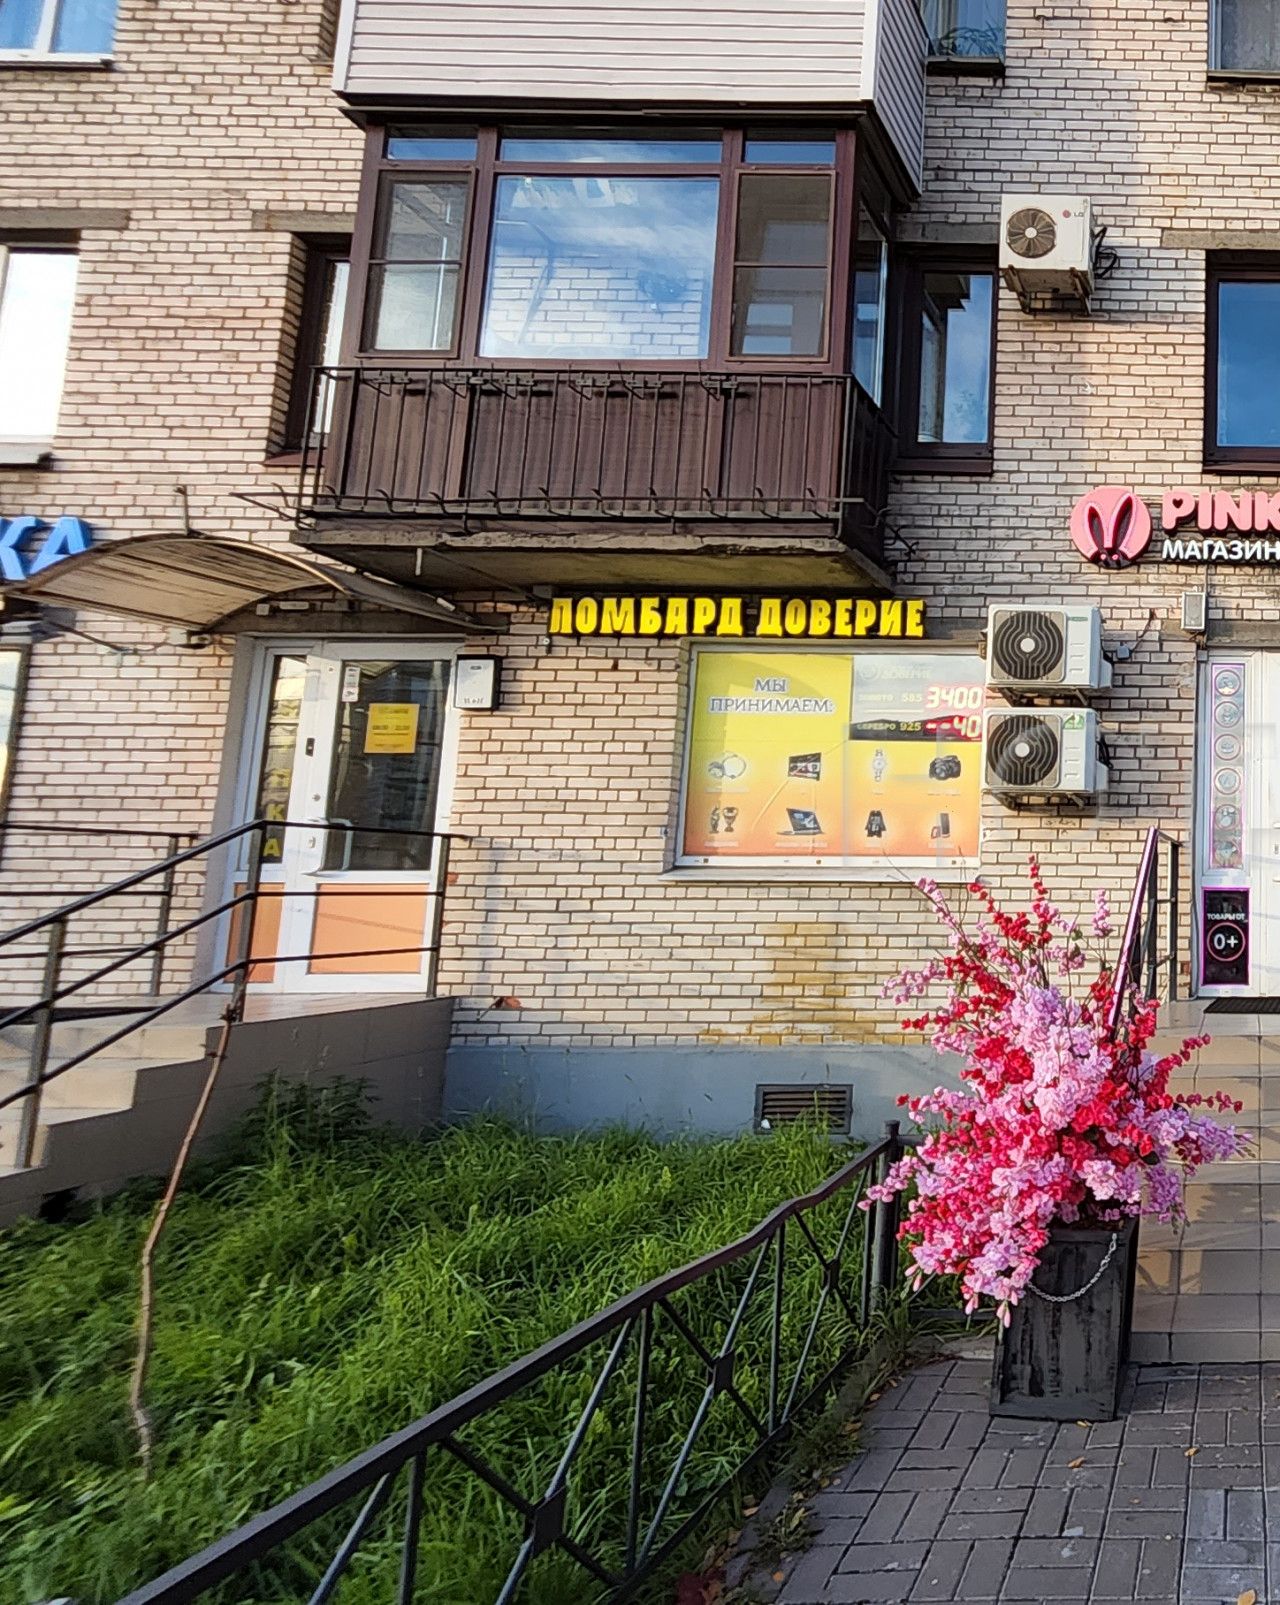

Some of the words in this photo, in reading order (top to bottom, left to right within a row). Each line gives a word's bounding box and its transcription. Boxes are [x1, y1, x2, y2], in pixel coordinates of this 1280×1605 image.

[549, 597, 744, 637] ЛОМБАРД
[756, 599, 924, 638] ДОВЕРИЕ
[754, 678, 787, 693] МЫ
[710, 698, 833, 713] ПРИНИМАЕМ:
[926, 686, 982, 709] 3400
[900, 722, 921, 732] 925
[1213, 933, 1239, 950] 0+
